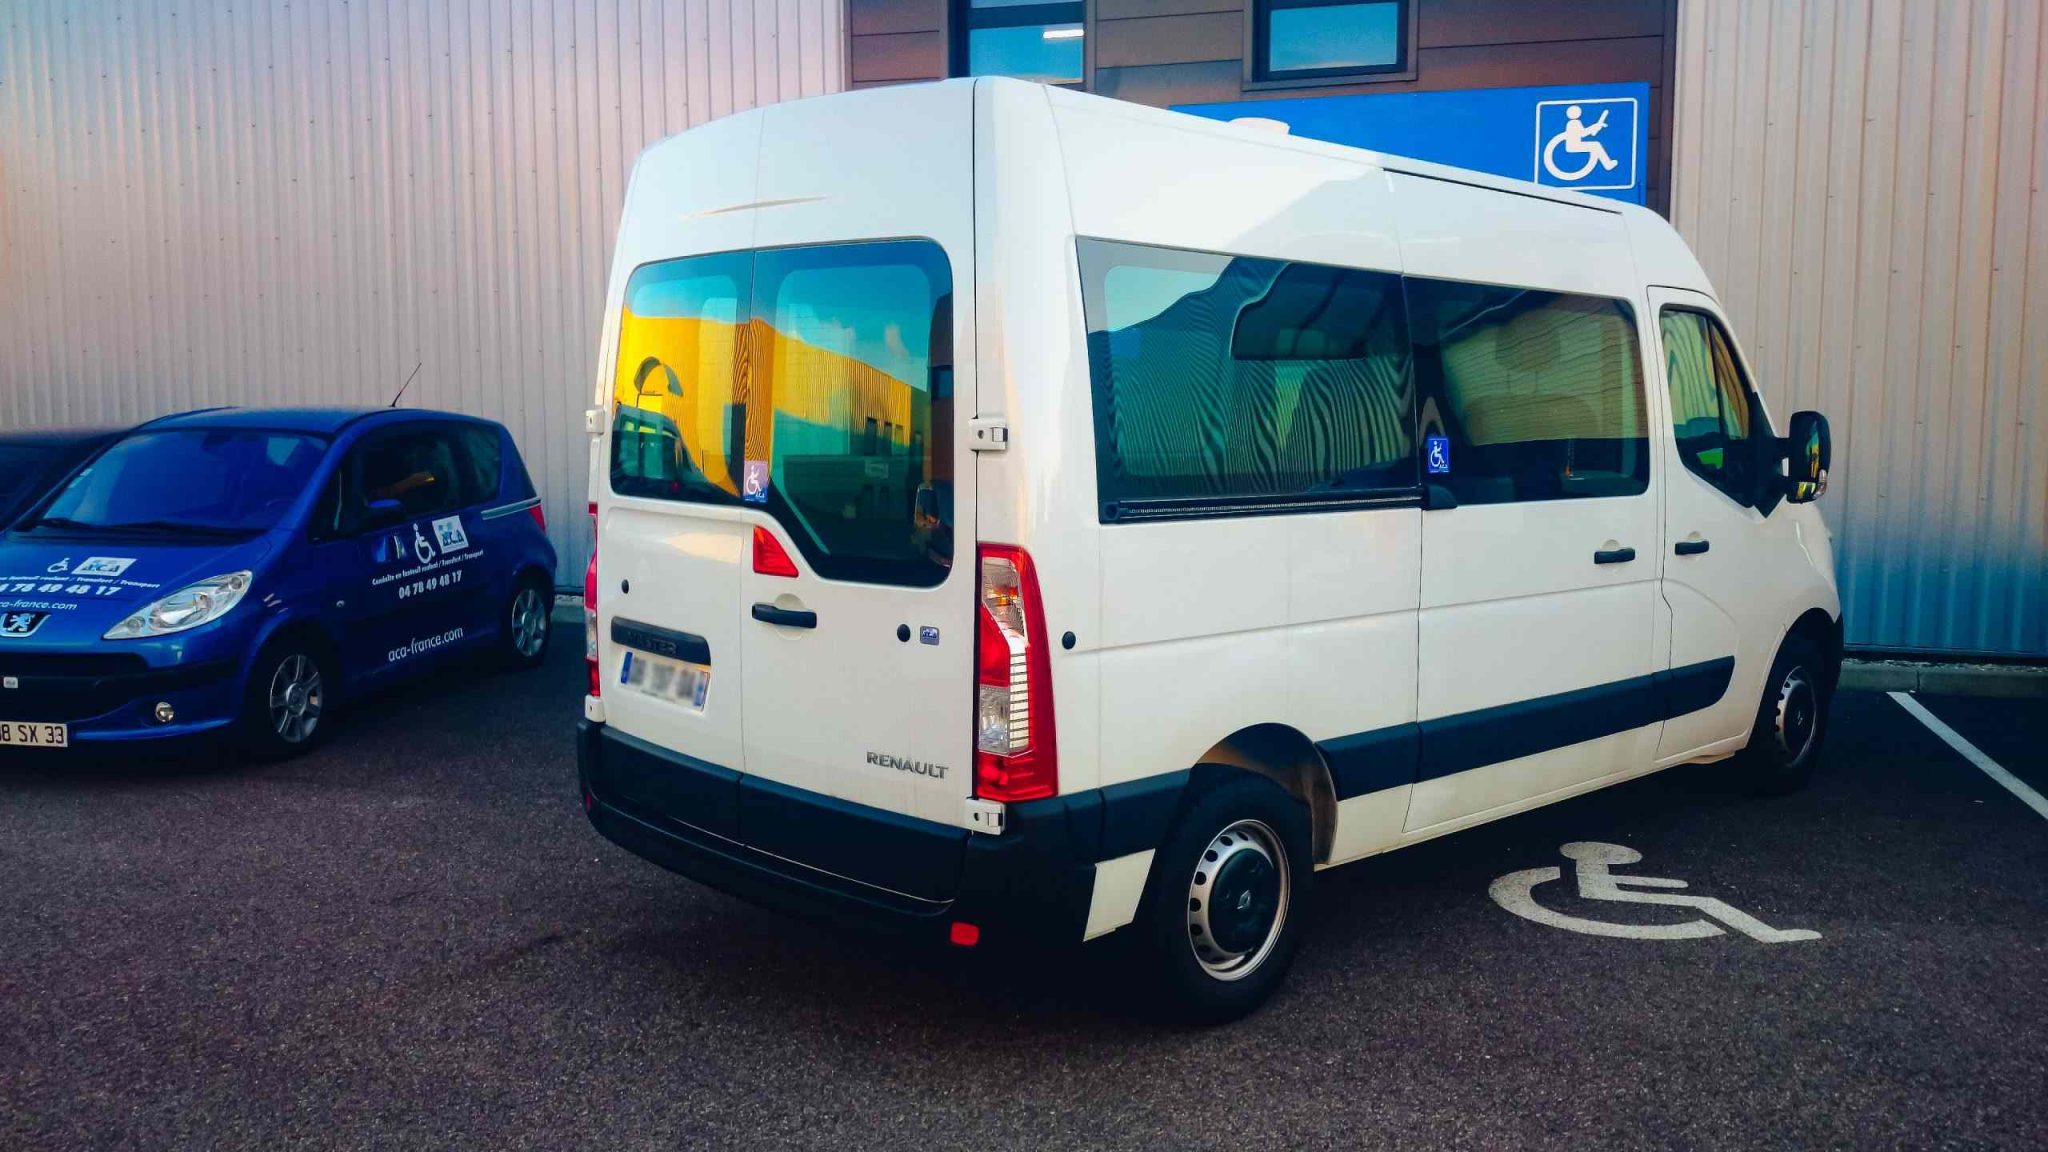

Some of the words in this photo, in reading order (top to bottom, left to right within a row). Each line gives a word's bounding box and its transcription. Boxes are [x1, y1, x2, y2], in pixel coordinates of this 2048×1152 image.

[10, 583, 36, 593] 78
[38, 583, 63, 593] 49
[65, 584, 92, 594] 48
[95, 585, 122, 596] 17
[398, 585, 411, 599] 04
[412, 581, 425, 595] 78
[426, 577, 437, 591] 49
[439, 573, 450, 587] 48
[452, 570, 463, 583] 17
[388, 627, 464, 662] aca-france.com
[18, 724, 39, 743] SX
[44, 725, 65, 744] 33
[866, 751, 949, 780] RENAULT
